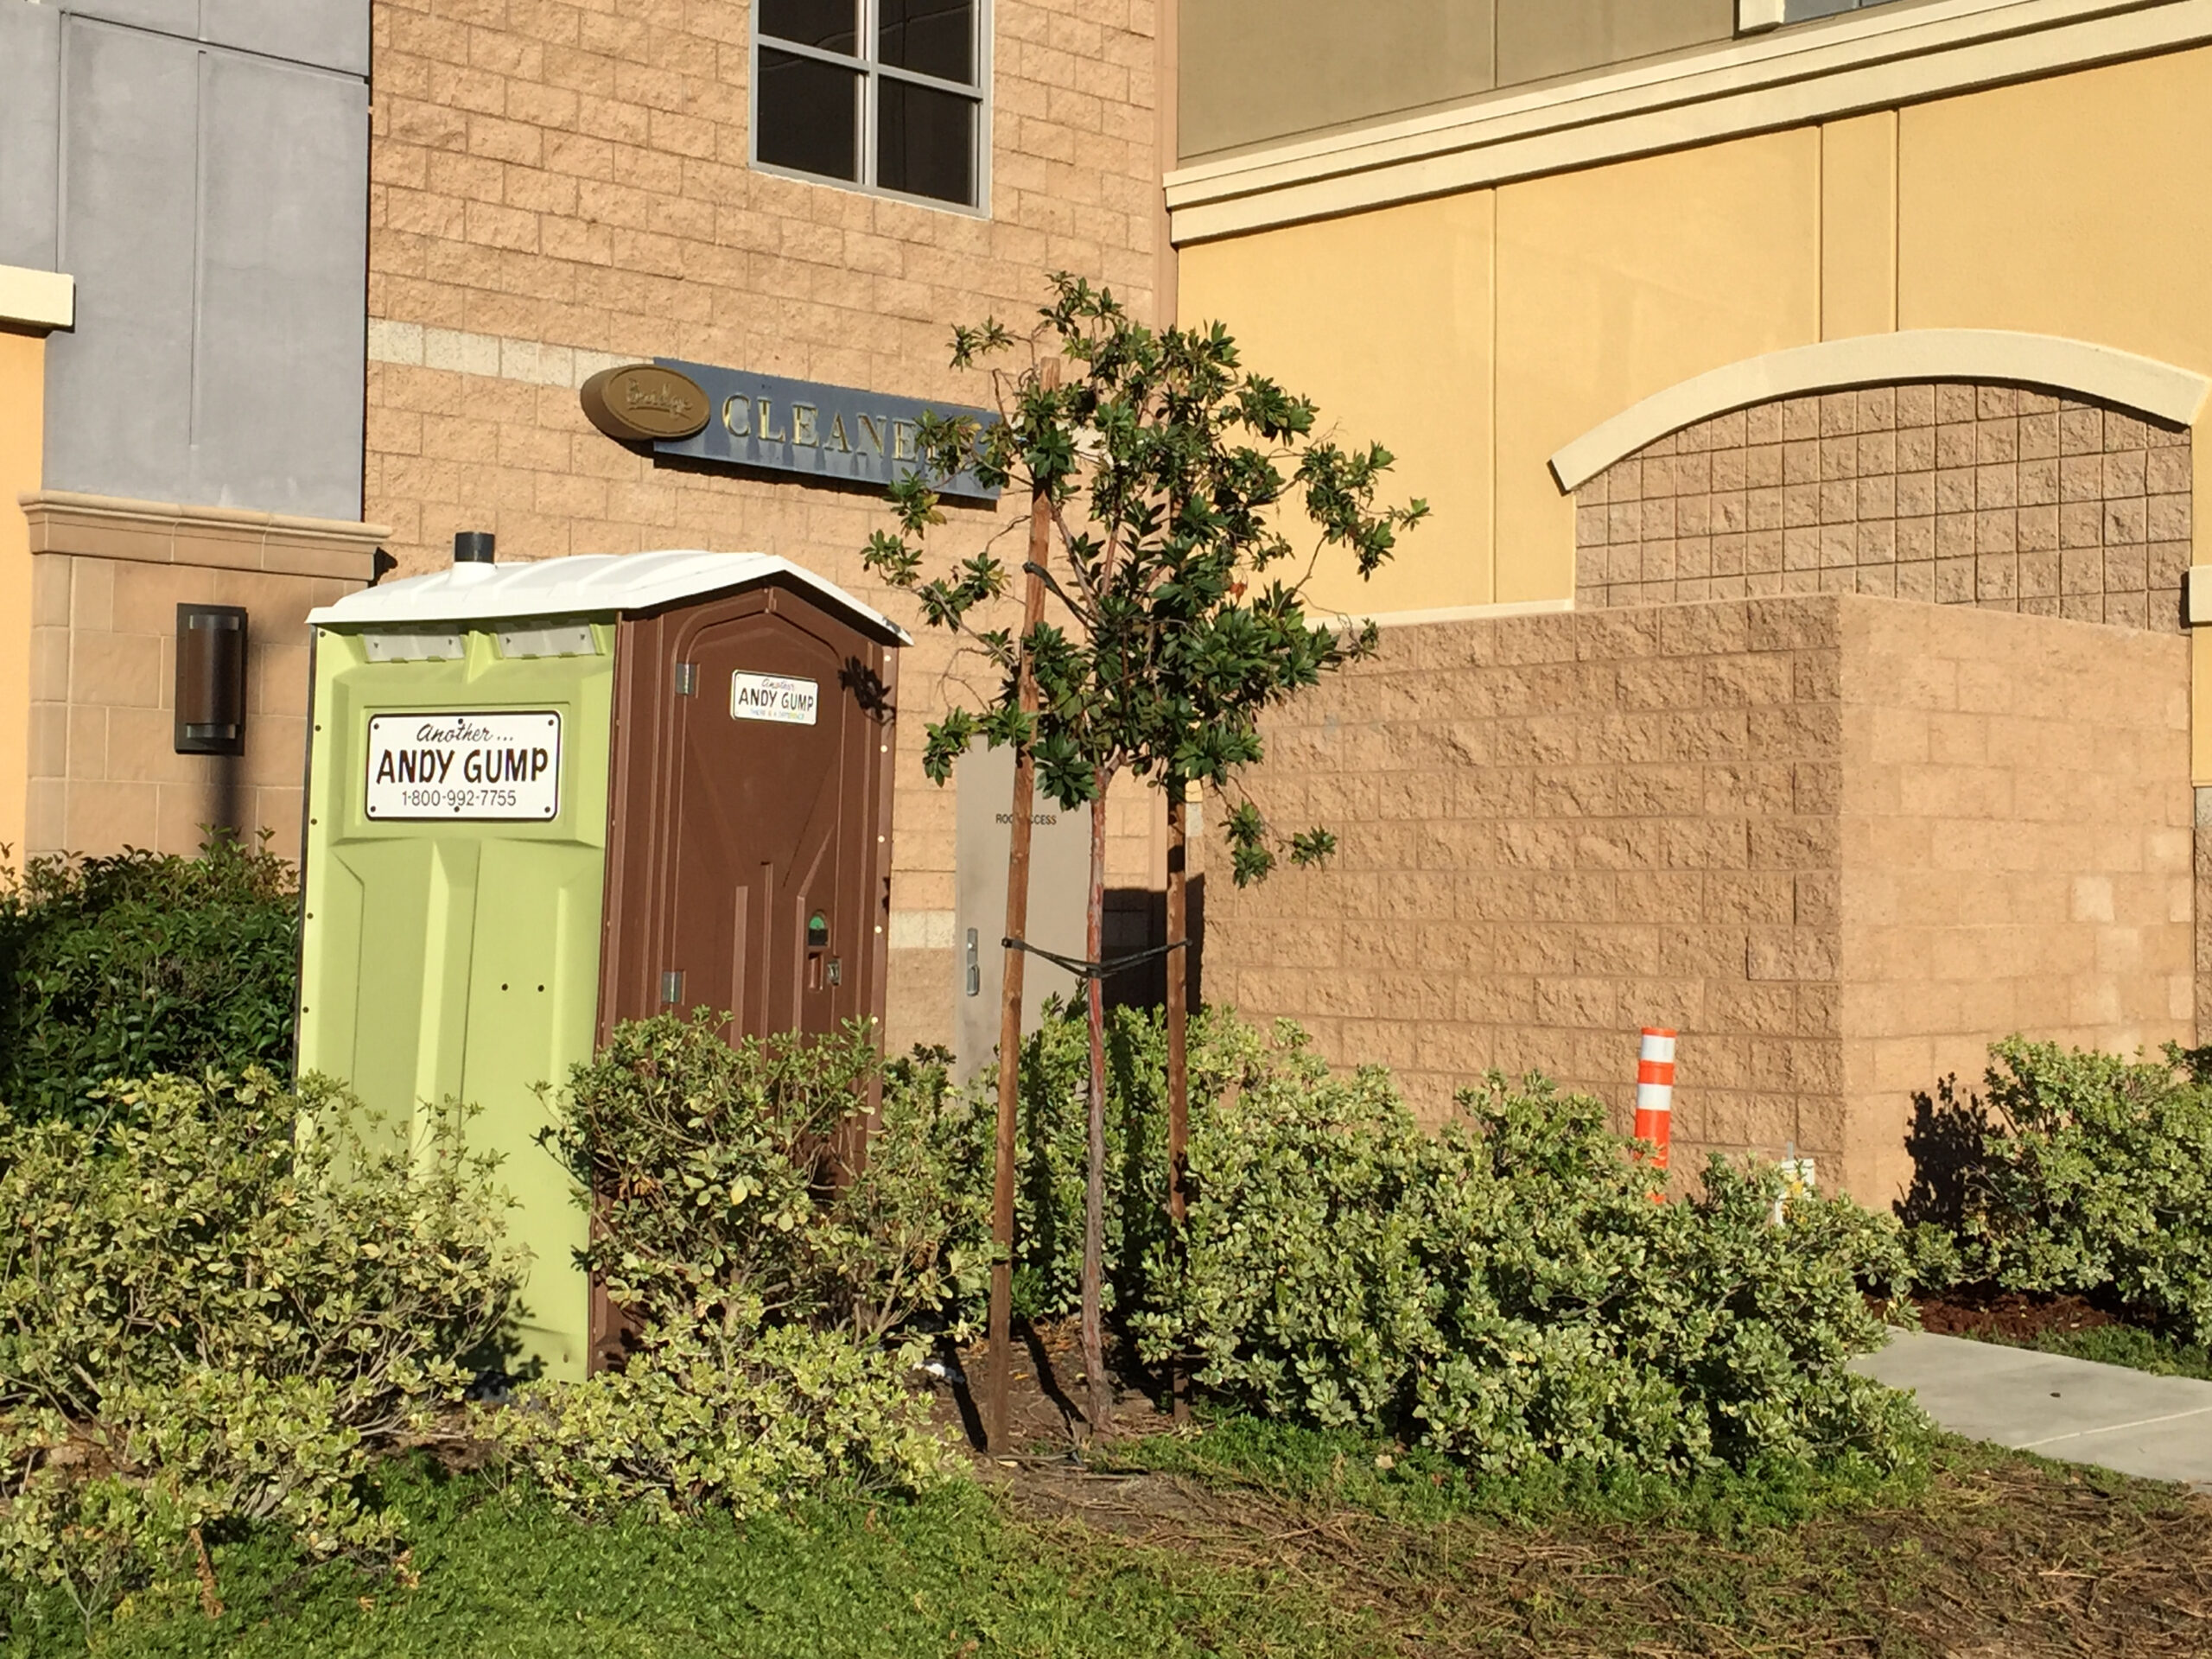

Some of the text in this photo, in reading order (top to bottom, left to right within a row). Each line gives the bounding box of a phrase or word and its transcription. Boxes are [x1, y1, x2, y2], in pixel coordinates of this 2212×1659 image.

[721, 393, 969, 468] CLEANE
[739, 687, 814, 711] ANDY GUMP
[376, 747, 549, 784] ANDY GUMP
[402, 790, 517, 806] 1-800-992-7755
